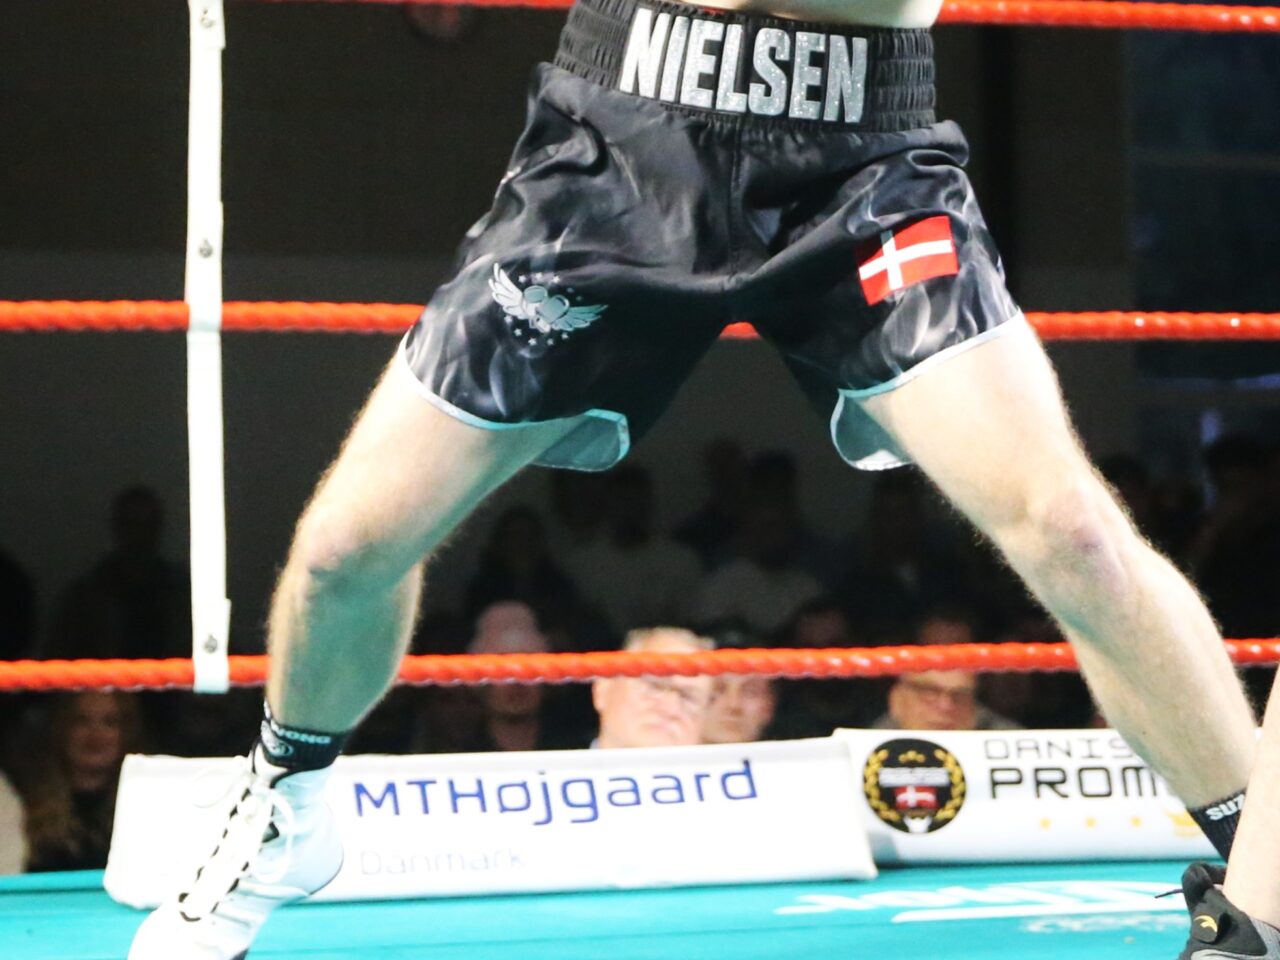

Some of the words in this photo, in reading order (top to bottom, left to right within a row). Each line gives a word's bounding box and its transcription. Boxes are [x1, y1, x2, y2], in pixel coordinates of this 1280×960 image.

[618, 7, 868, 124] NIELSEN
[984, 736, 1135, 760] DANIS
[354, 758, 759, 826] MTHøjgaard
[989, 765, 1158, 800] PROM
[1206, 793, 1245, 821] SUZ
[359, 847, 527, 876] Danmark
